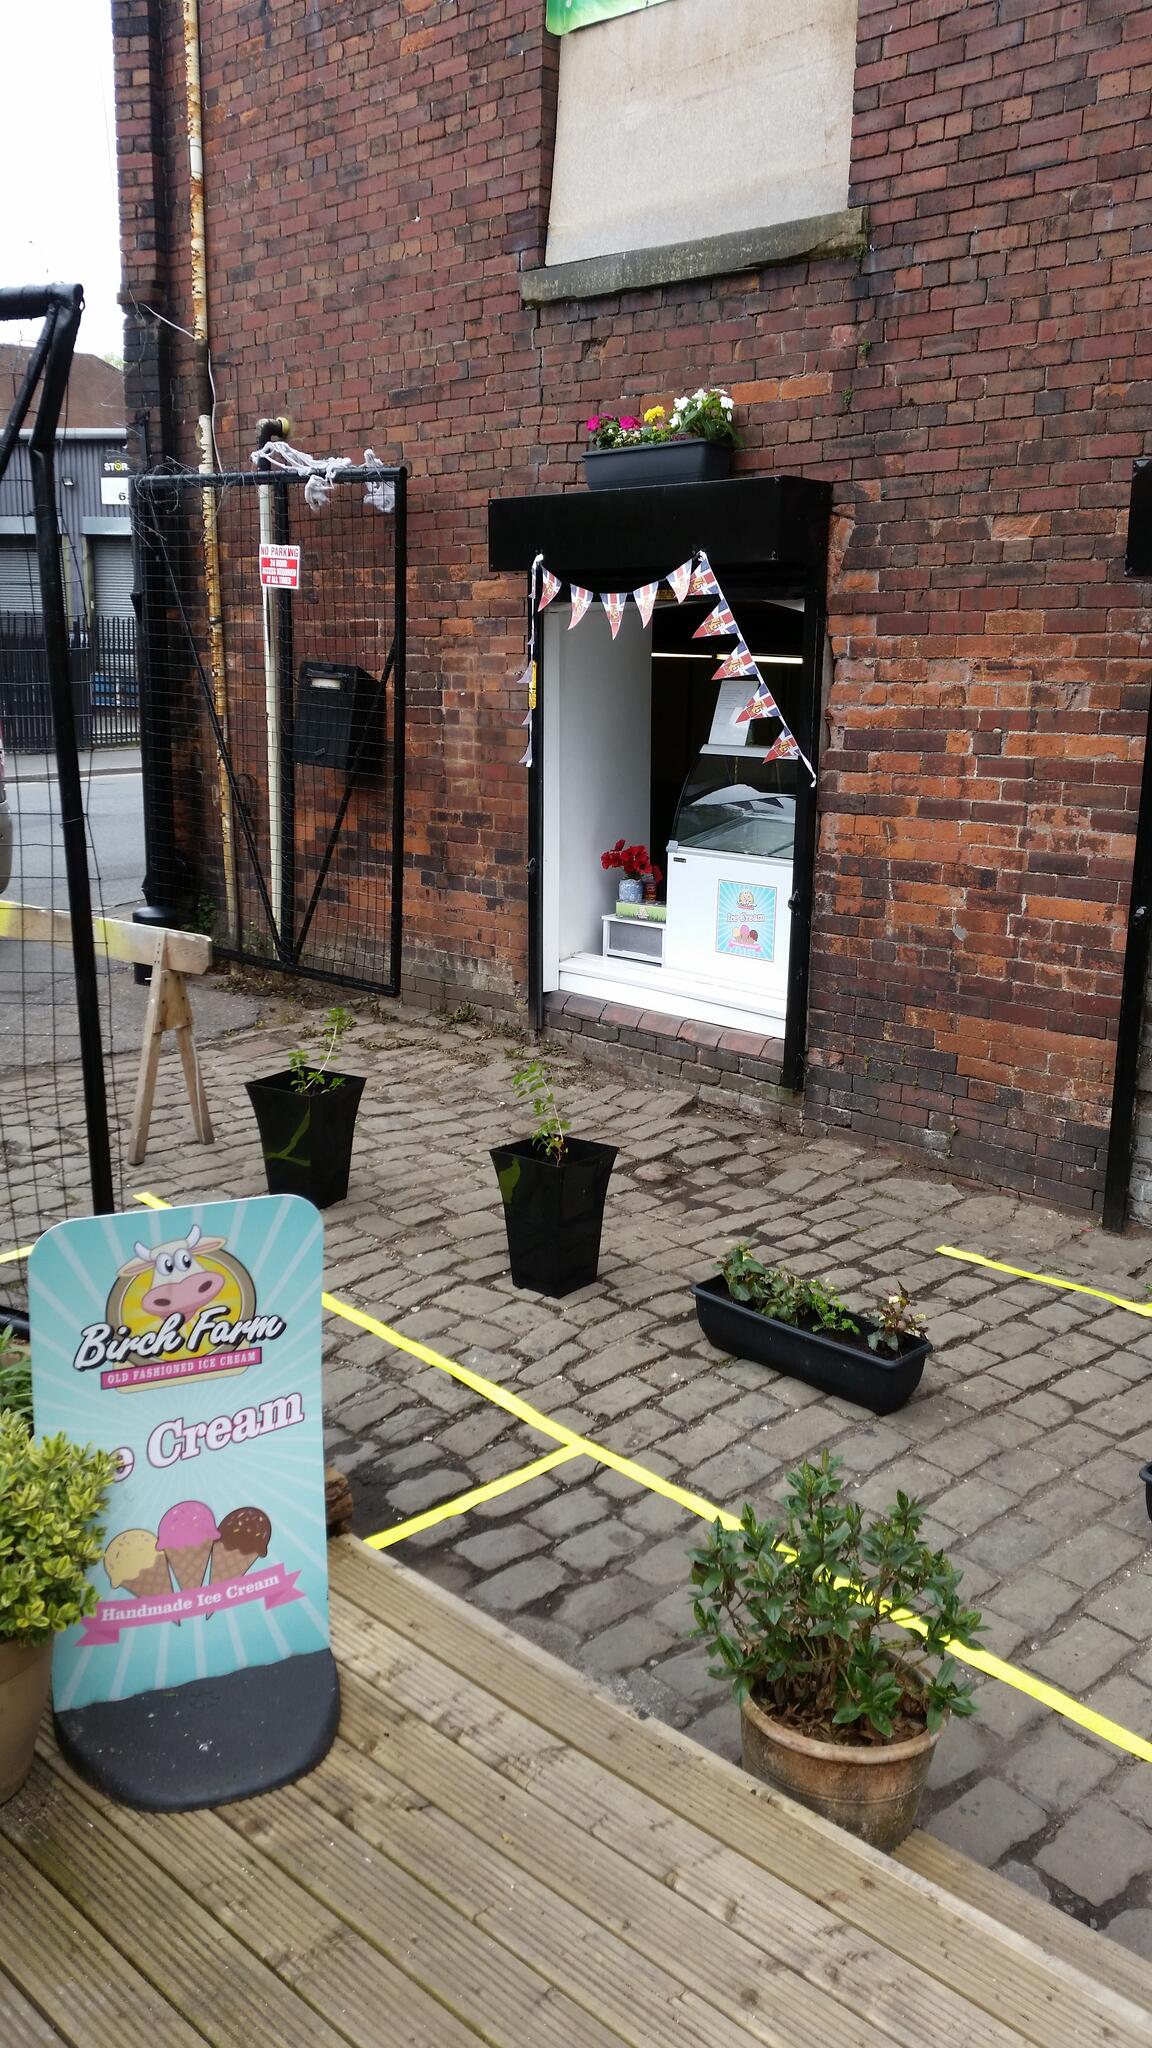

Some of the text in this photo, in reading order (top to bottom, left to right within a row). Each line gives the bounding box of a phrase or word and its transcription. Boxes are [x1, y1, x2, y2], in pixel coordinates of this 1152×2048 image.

[261, 546, 299, 557] NO PARKING
[73, 1306, 286, 1372] Birch Farm
[107, 1351, 256, 1384] OLD FASHIONED ICE CREAM
[146, 1392, 304, 1469] Cream
[101, 1574, 280, 1622] Handmade Ice Cream
